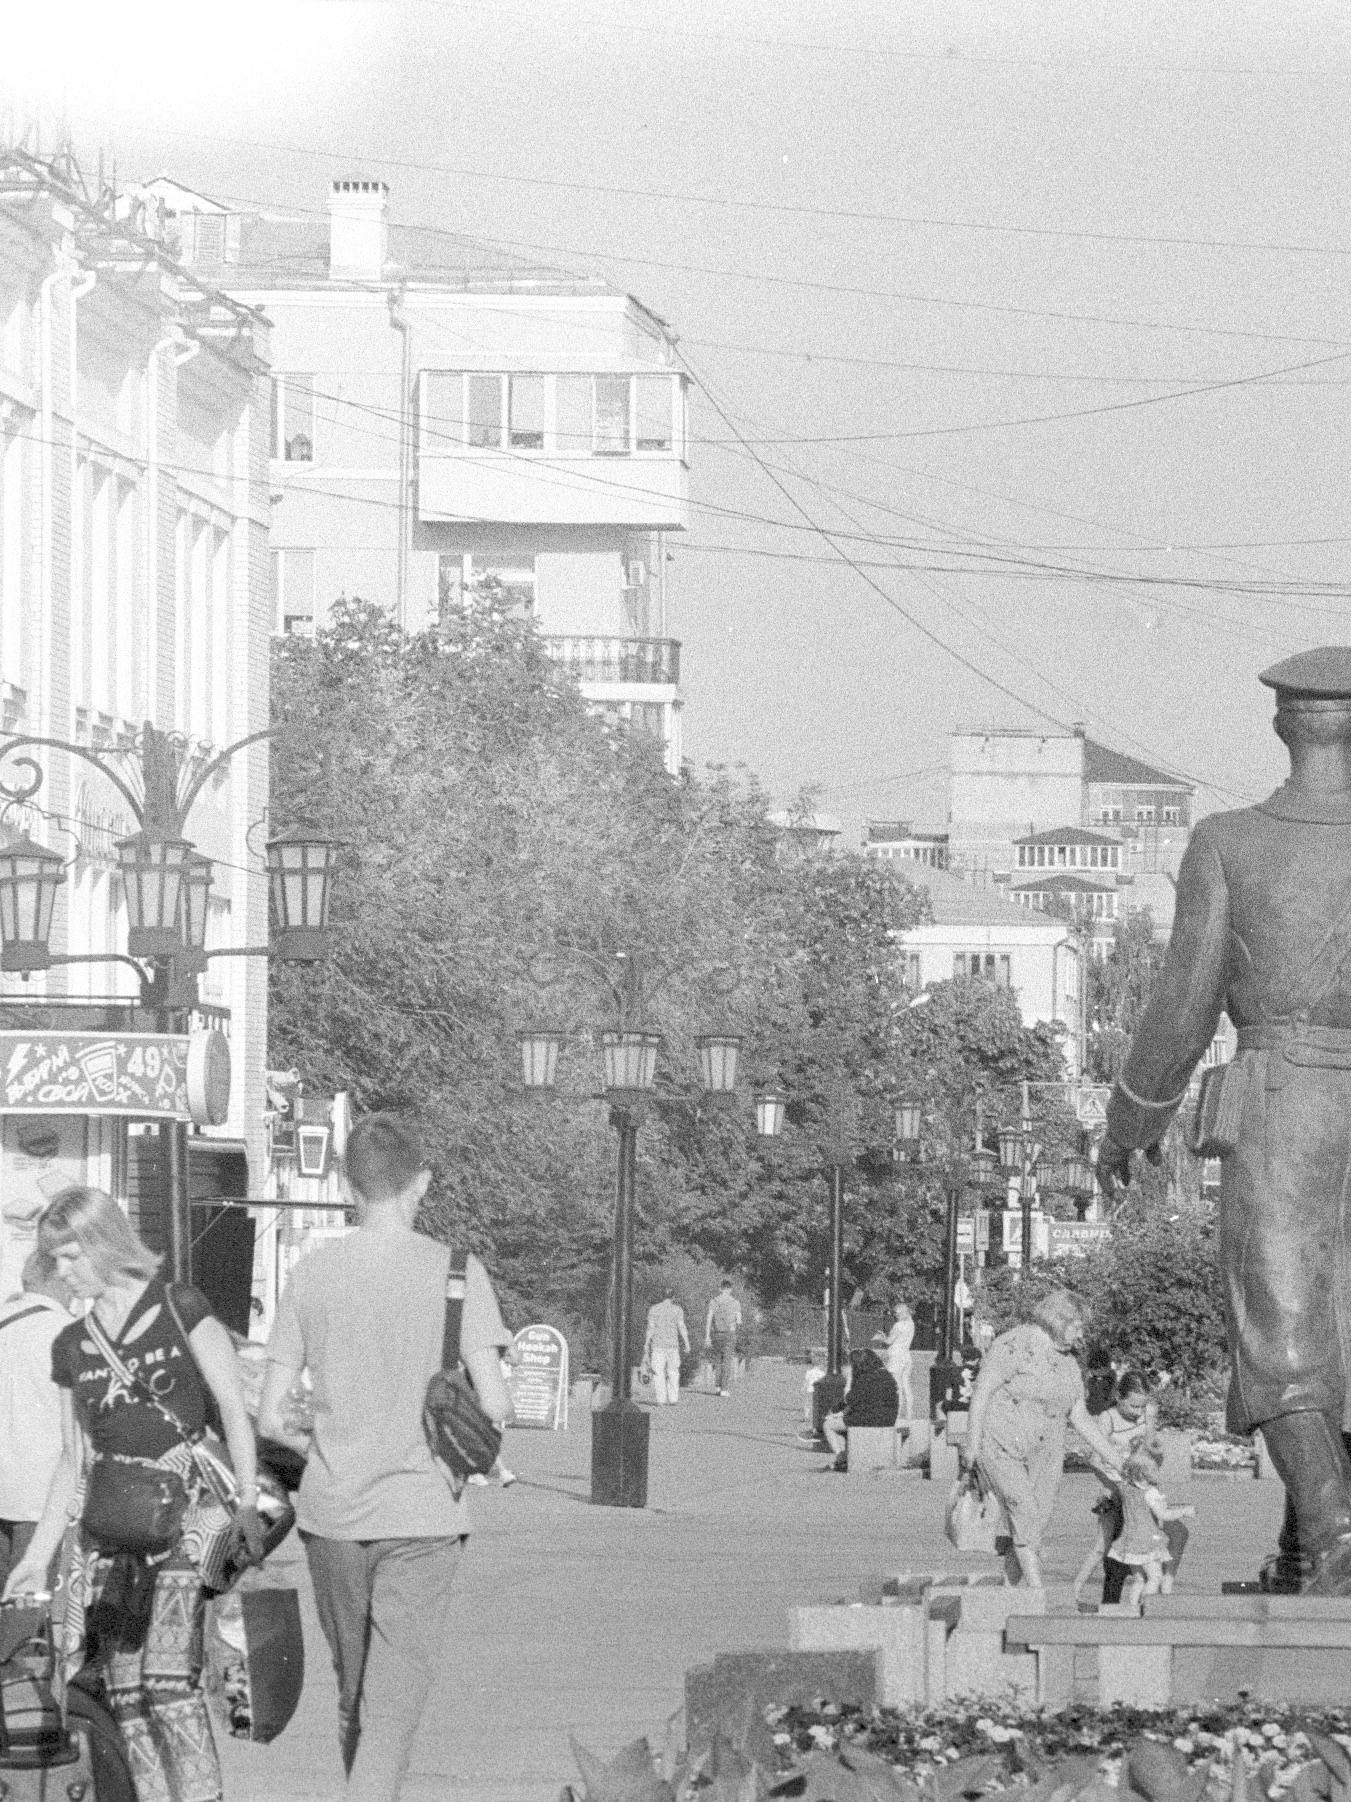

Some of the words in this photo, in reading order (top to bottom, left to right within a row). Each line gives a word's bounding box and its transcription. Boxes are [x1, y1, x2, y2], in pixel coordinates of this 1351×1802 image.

[127, 1046, 161, 1079] 49
[145, 1347, 165, 1365] BE
[171, 1345, 181, 1358] A
